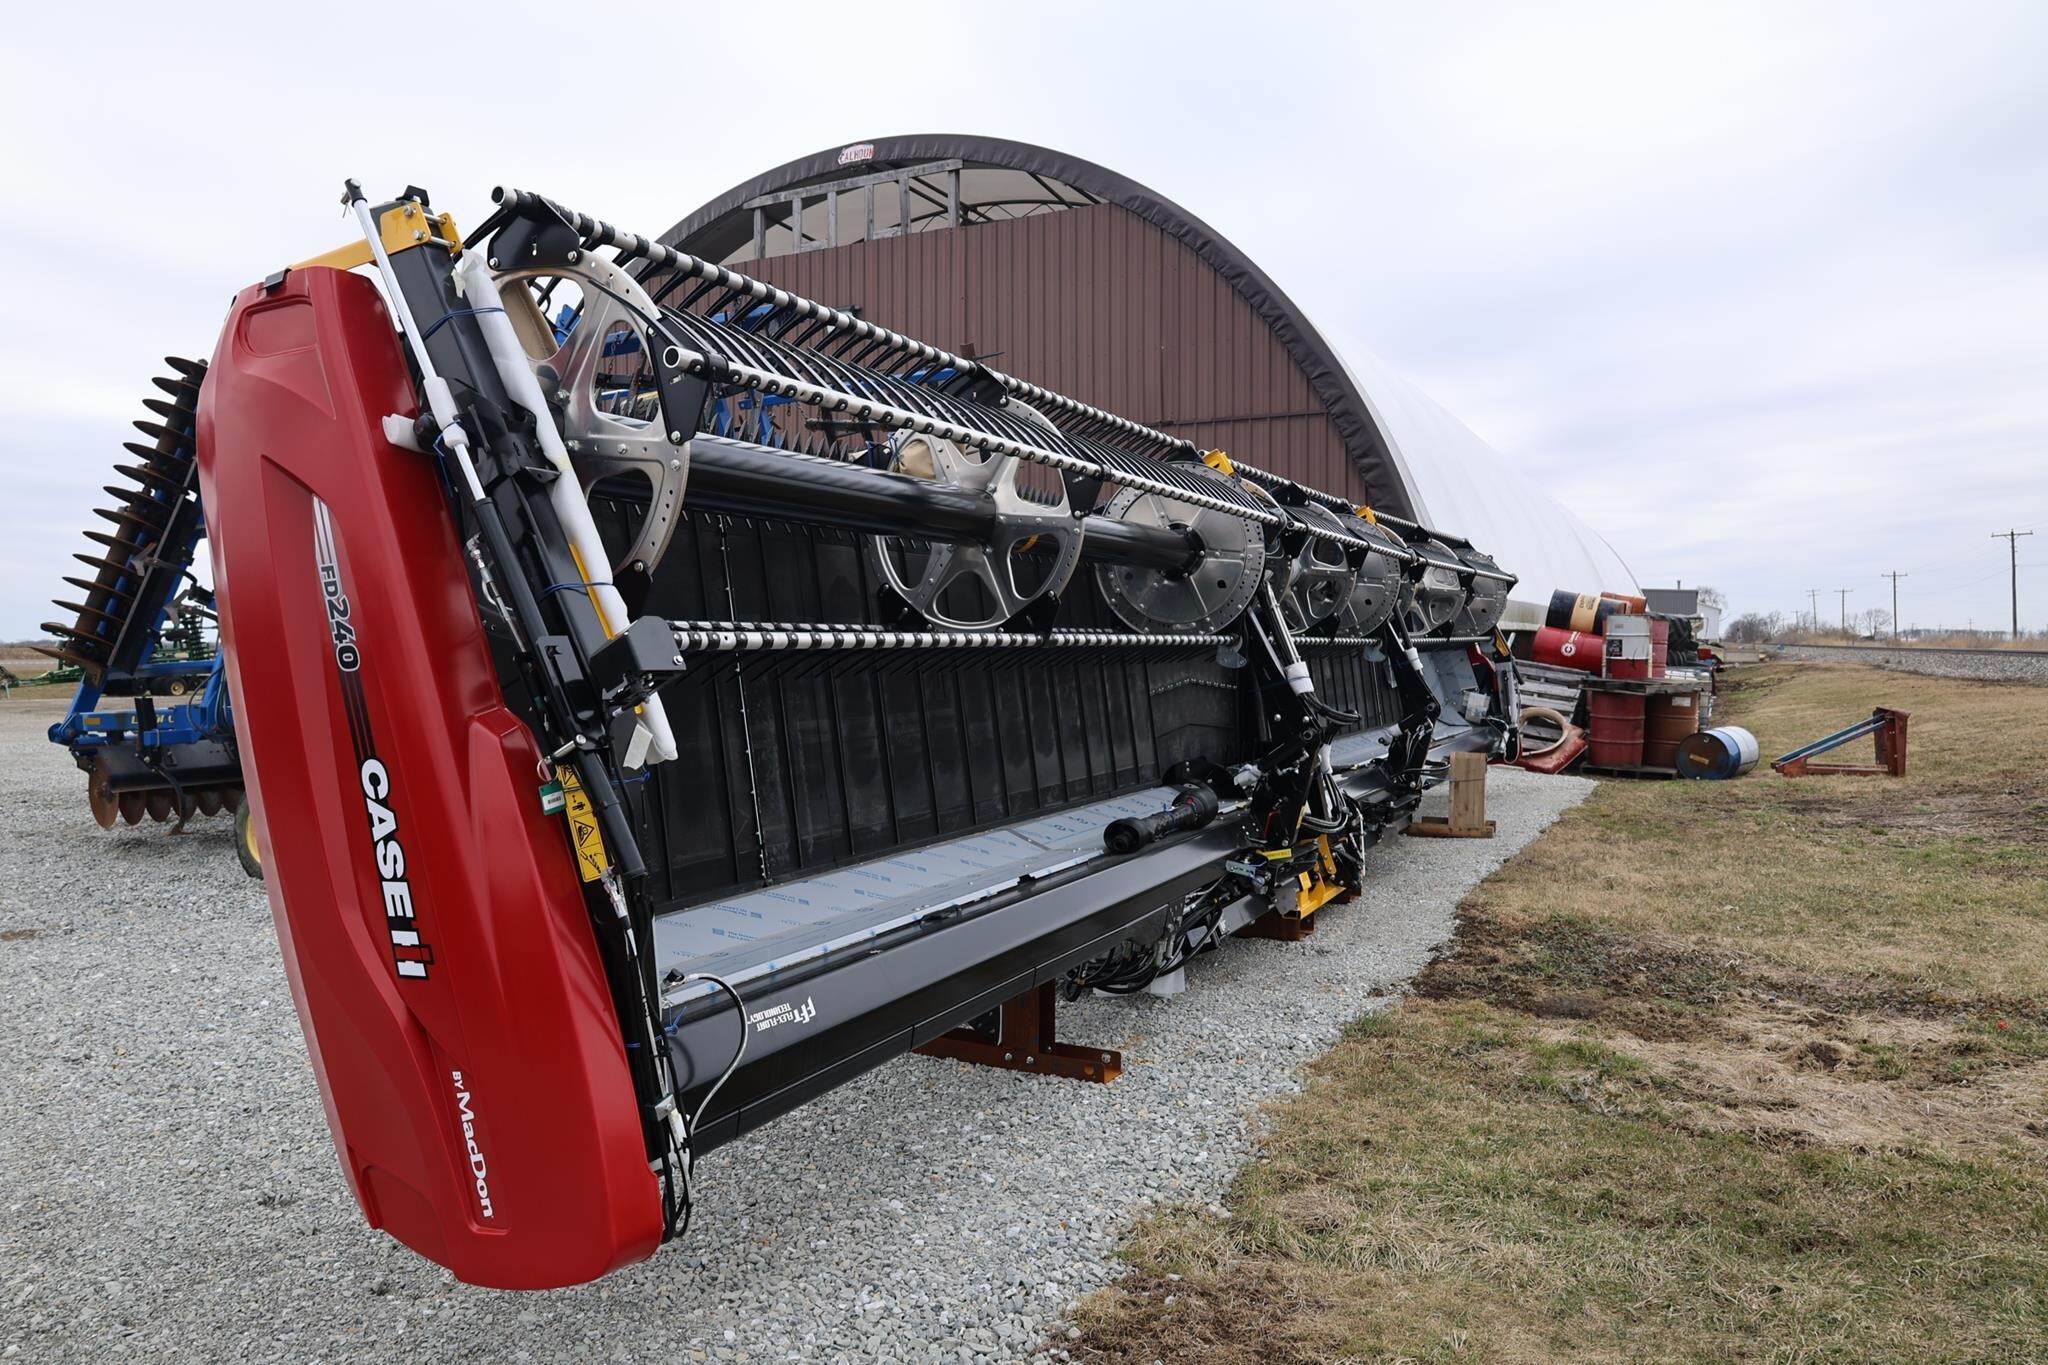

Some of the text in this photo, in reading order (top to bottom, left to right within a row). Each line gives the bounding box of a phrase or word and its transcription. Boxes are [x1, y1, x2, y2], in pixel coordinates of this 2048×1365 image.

[320, 565, 361, 672] FD240
[361, 758, 414, 918] CASE
[750, 1003, 792, 1023] TECHNOLOGY
[756, 1011, 794, 1032] FLEX-FLOAT
[794, 996, 816, 1024] FFT
[452, 1071, 493, 1217] BY MacDon
